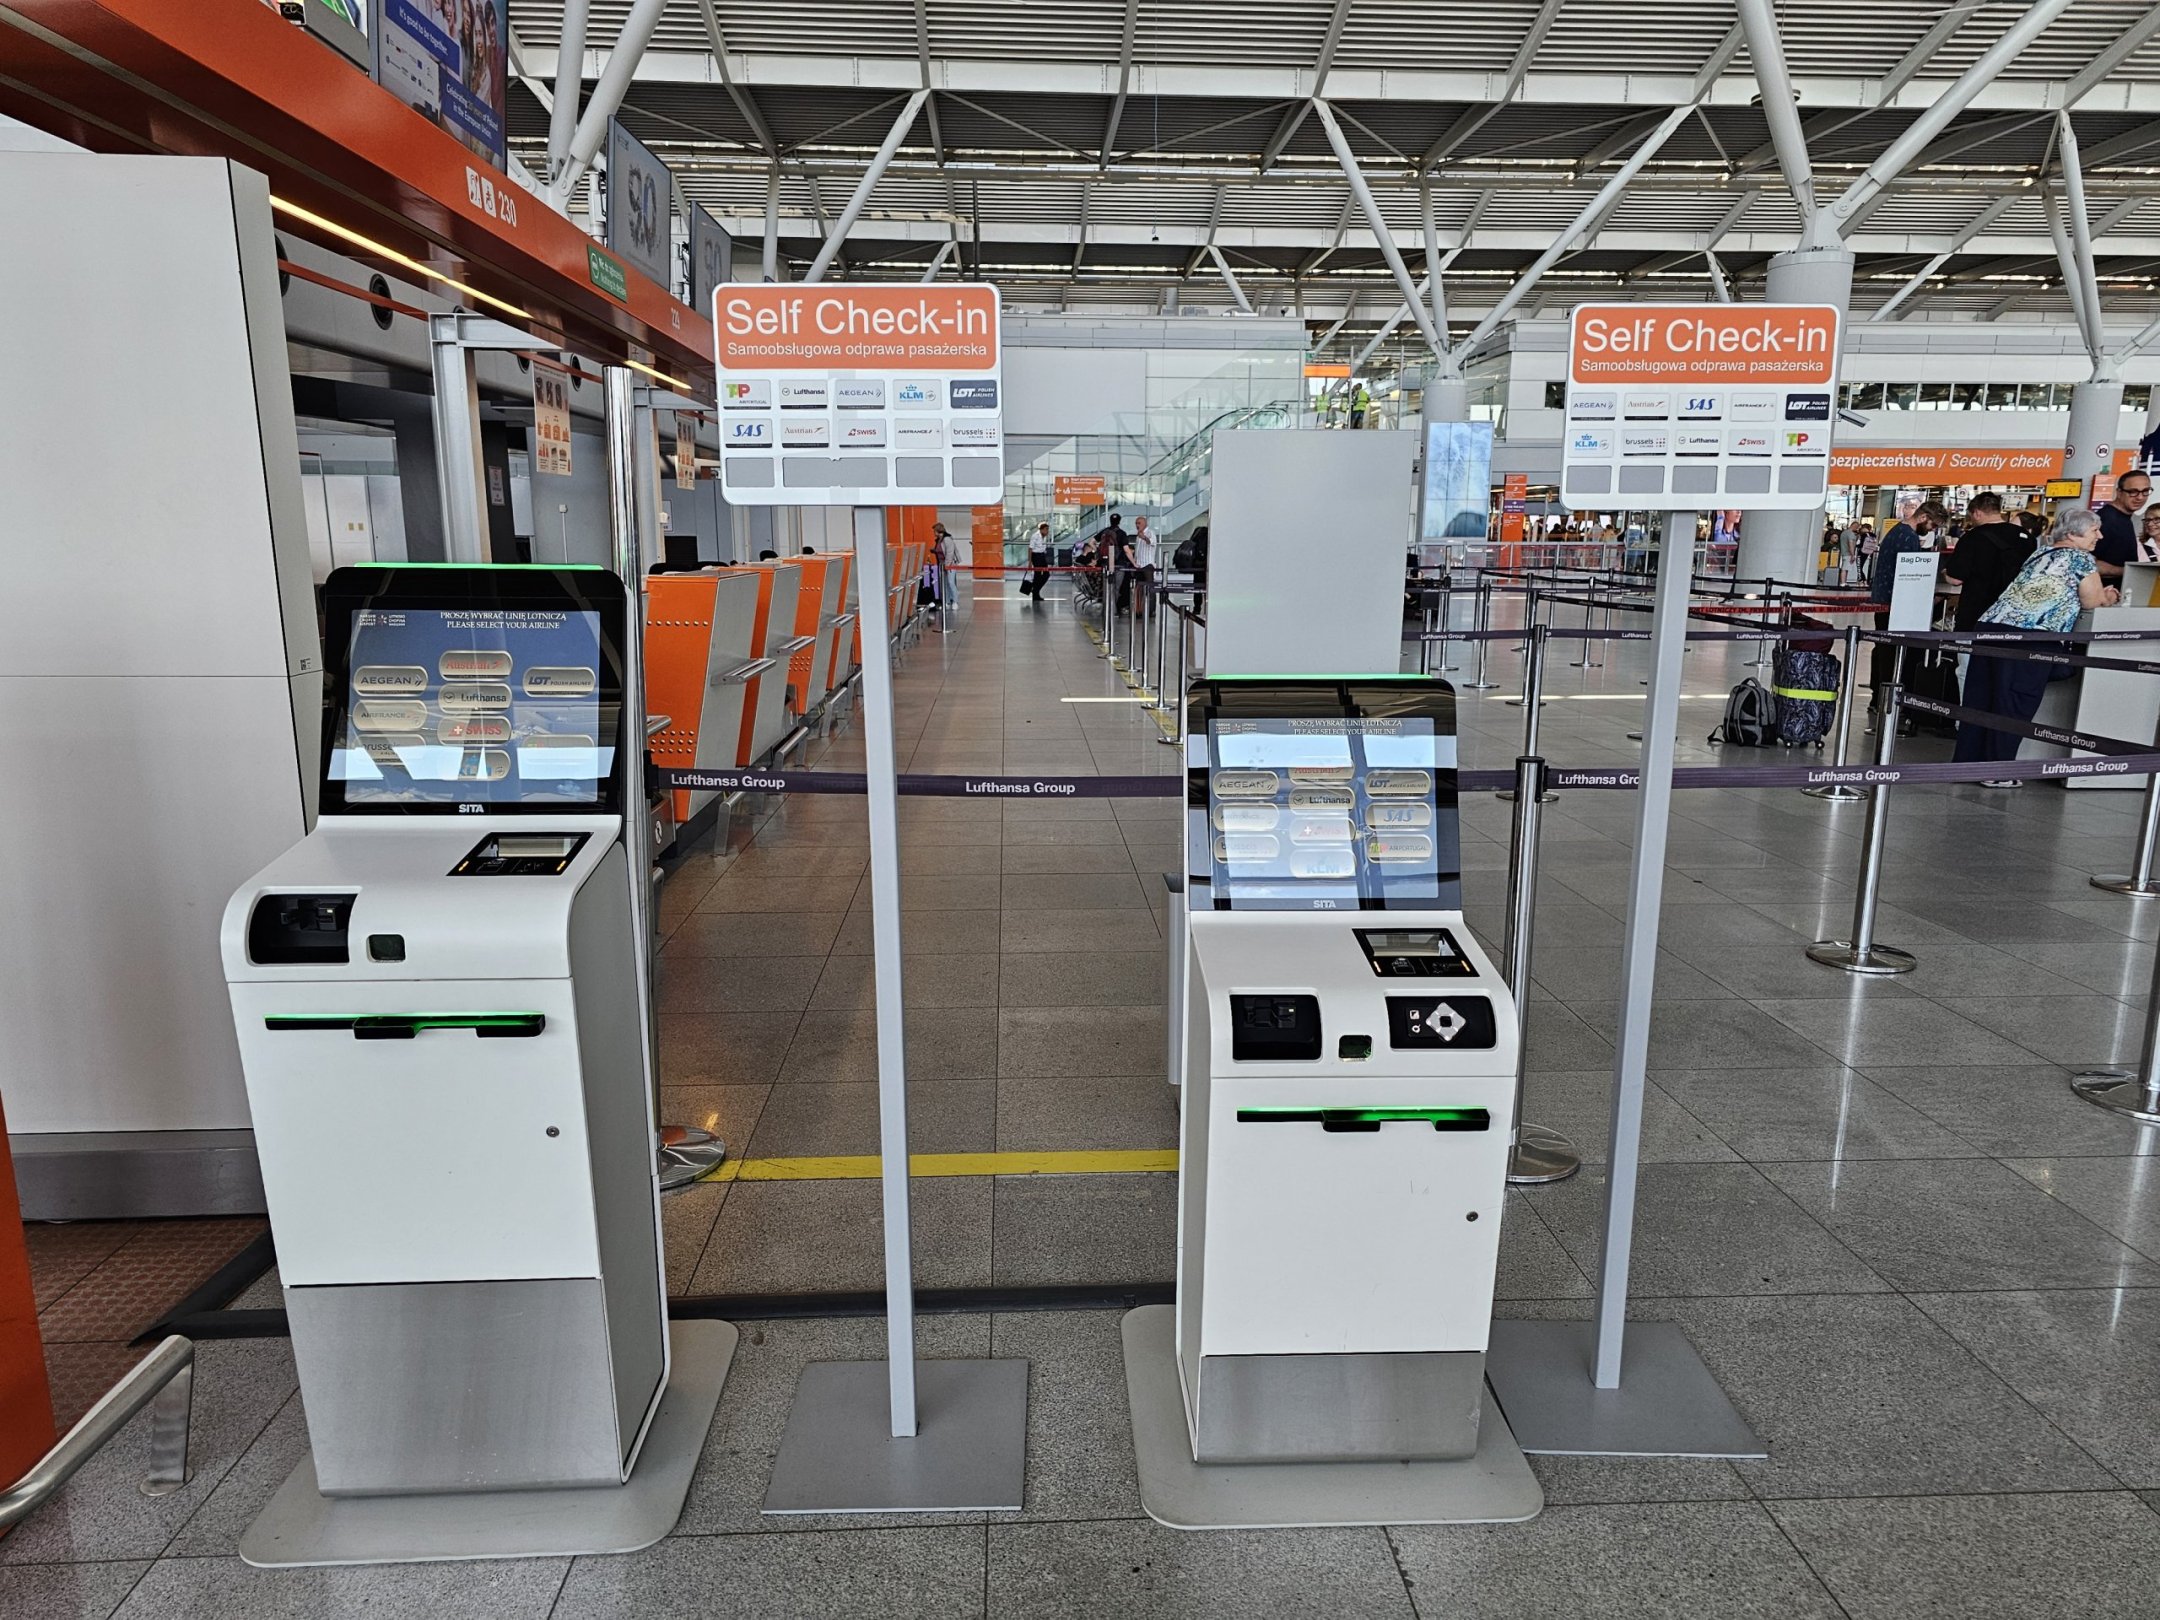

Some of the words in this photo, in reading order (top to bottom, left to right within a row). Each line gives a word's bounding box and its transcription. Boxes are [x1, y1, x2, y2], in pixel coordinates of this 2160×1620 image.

[498, 190, 517, 228] 230
[726, 299, 803, 335] Self
[815, 299, 988, 335] Check-in
[1582, 319, 1656, 352] Self
[1665, 319, 1827, 352] Check-in
[727, 342, 841, 358] Samoobsługowa
[845, 343, 904, 358] odprawa
[909, 342, 987, 358] pasażerska
[1581, 359, 1686, 374] Samoobsługowa
[1690, 359, 1746, 374] odprawa
[1750, 359, 1823, 374] pasażerska
[952, 388, 975, 398] LOT
[1685, 398, 1716, 410] SAS
[1787, 401, 1811, 410] LOT
[732, 424, 764, 437] SAS
[1575, 440, 1598, 448] KLM
[1950, 453, 2006, 471] Security
[2009, 454, 2053, 468] check
[1900, 556, 1914, 564] Bag
[440, 612, 470, 621] PROSZĘ
[471, 611, 504, 620] WYBRAĆ
[505, 612, 526, 621] LINIĘ
[527, 613, 567, 621] LOTNICZĄ
[447, 621, 475, 629] PLEASE
[476, 621, 504, 629] SELECT
[506, 621, 528, 629] YOUR
[528, 621, 560, 629] AIRLINE
[2029, 653, 2052, 661] Lufthansa
[2053, 655, 2069, 663] Group
[360, 676, 411, 684] AEGEAN
[528, 676, 551, 685] LOT
[461, 694, 507, 702] Lufthansa
[1903, 696, 1931, 709] Lufthansa
[1932, 702, 1950, 715] Group
[1288, 720, 1314, 728] PROSZĘ
[1315, 719, 1346, 727] WYBRAĆ
[466, 725, 502, 735] SWISS
[2034, 727, 2069, 743] Lufthansa
[2071, 736, 2096, 749] Group
[2042, 763, 2093, 774] Lufthansa
[2095, 761, 2128, 772] Group
[1558, 774, 1616, 785] Lufthansa
[1620, 774, 1640, 785] Gro
[1808, 770, 1863, 782] Lufthansa
[1866, 769, 1900, 782] Group
[671, 773, 738, 787] Lufthansa
[742, 775, 786, 790] Group
[1369, 780, 1390, 788] LOT
[965, 781, 1030, 793] Lufthansa
[1034, 782, 1076, 795] Group
[1309, 796, 1351, 804] Lufthansa
[458, 804, 485, 813] SITA
[1384, 809, 1416, 822] SAS
[1306, 865, 1341, 873] KLM
[1313, 900, 1337, 908] SITA
